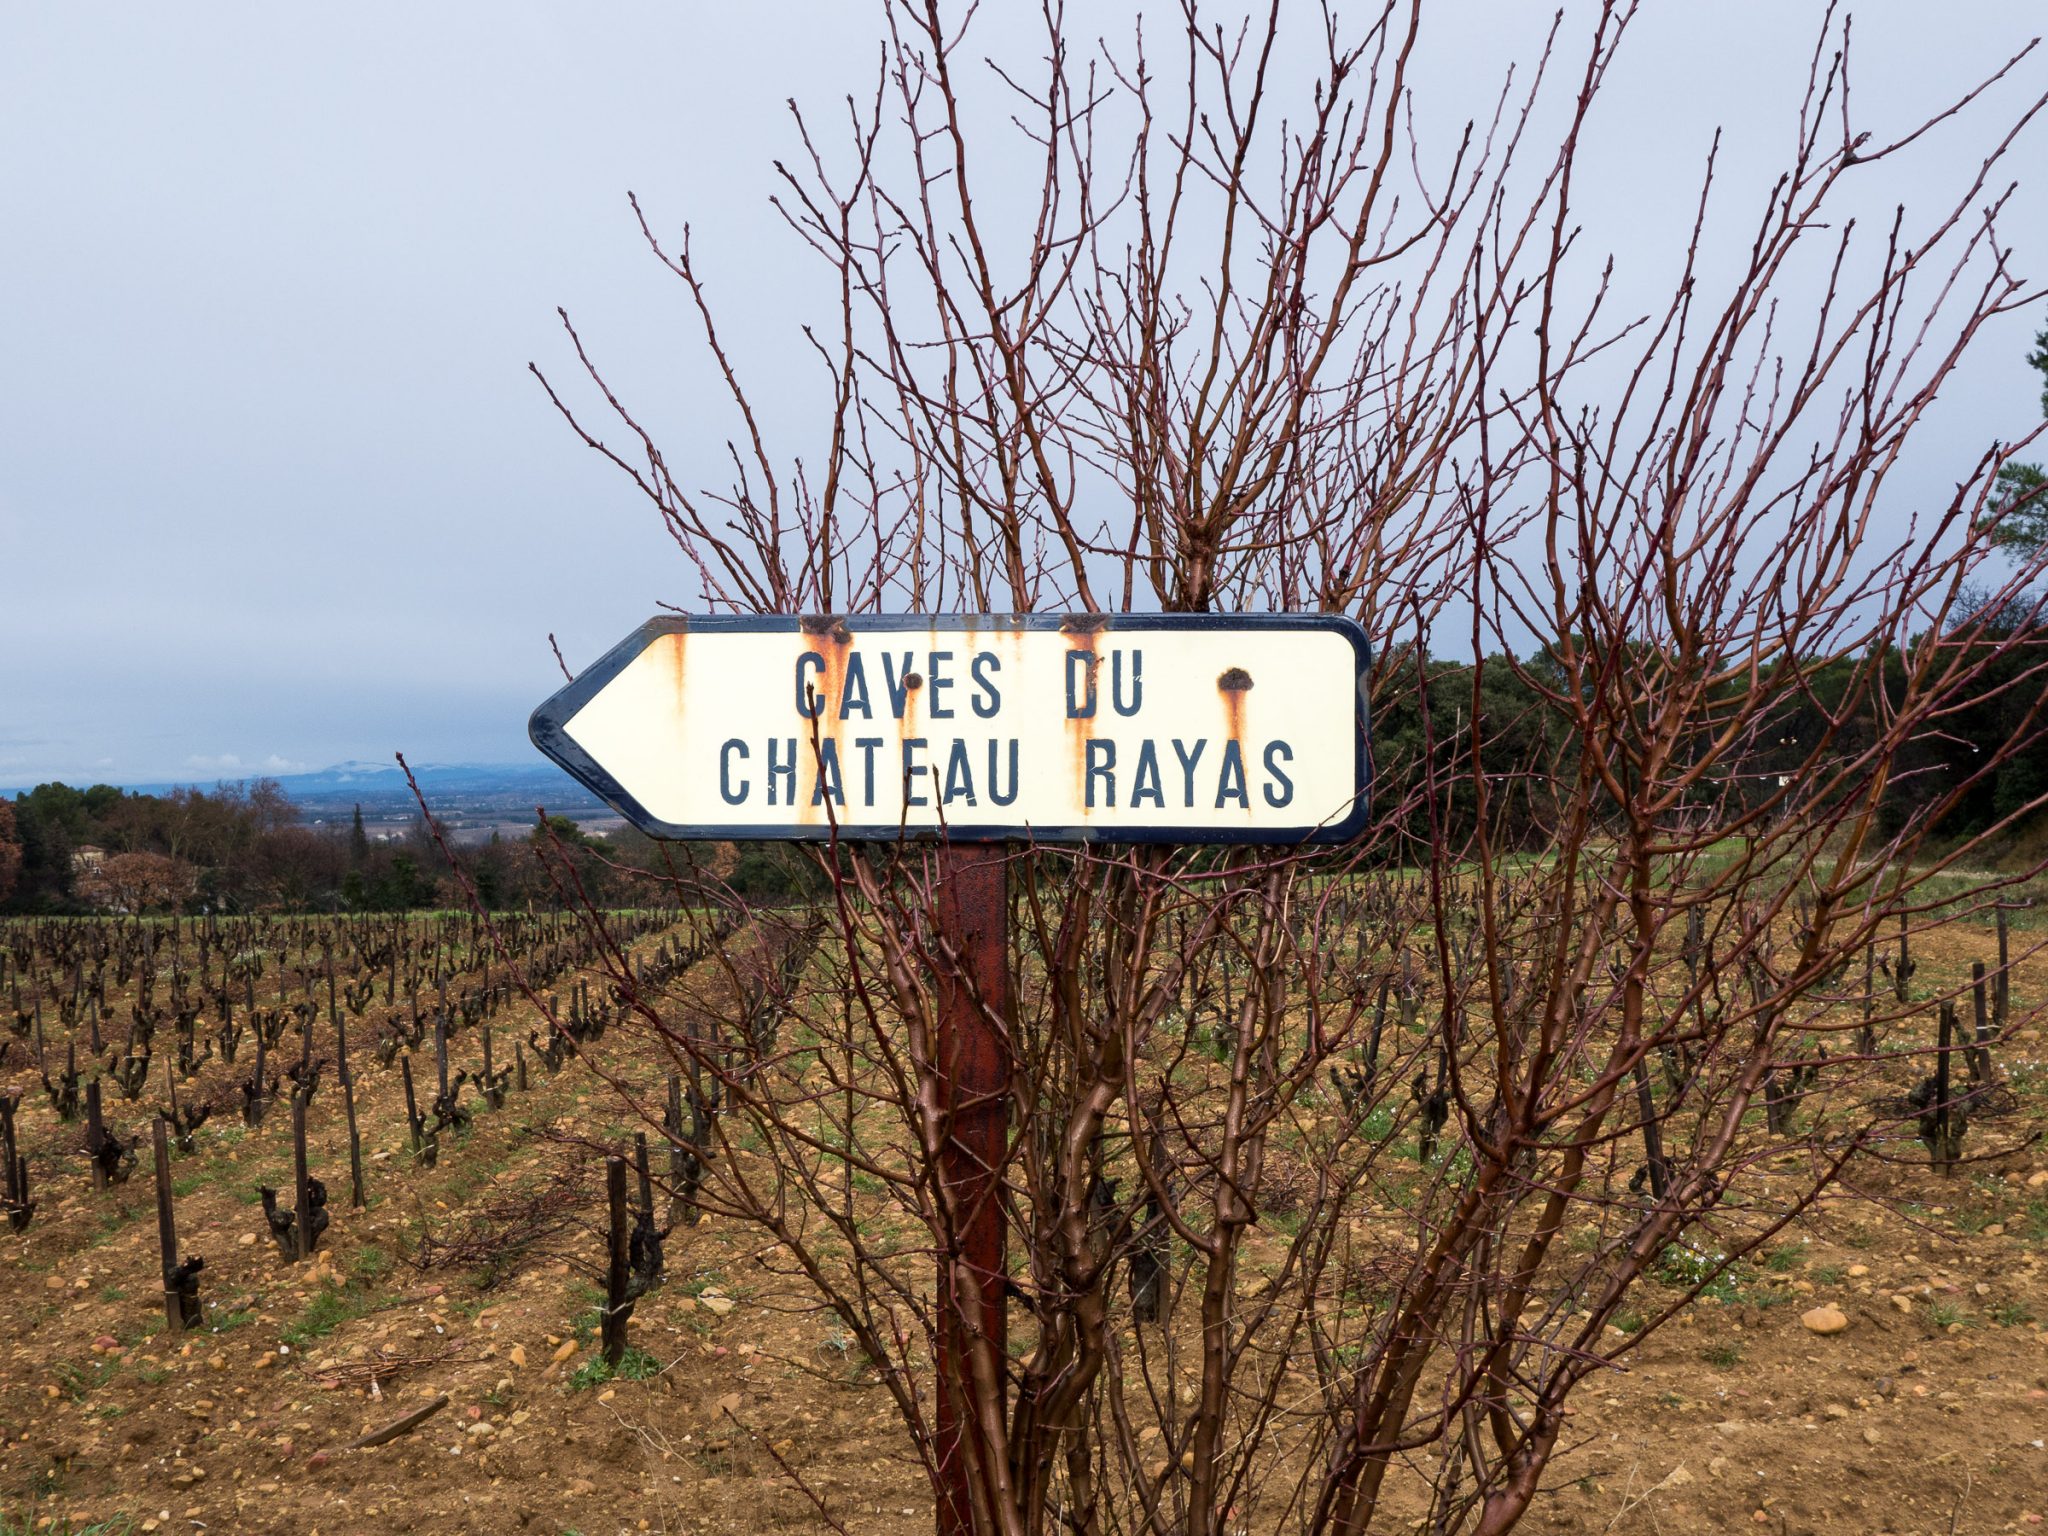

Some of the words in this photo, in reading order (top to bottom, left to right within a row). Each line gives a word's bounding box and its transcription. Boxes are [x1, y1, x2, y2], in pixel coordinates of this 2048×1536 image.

[796, 651, 1001, 719] CAVES
[1065, 649, 1142, 718] DU
[720, 737, 1018, 807] CHATEAU
[1085, 738, 1294, 808] RAYAS
